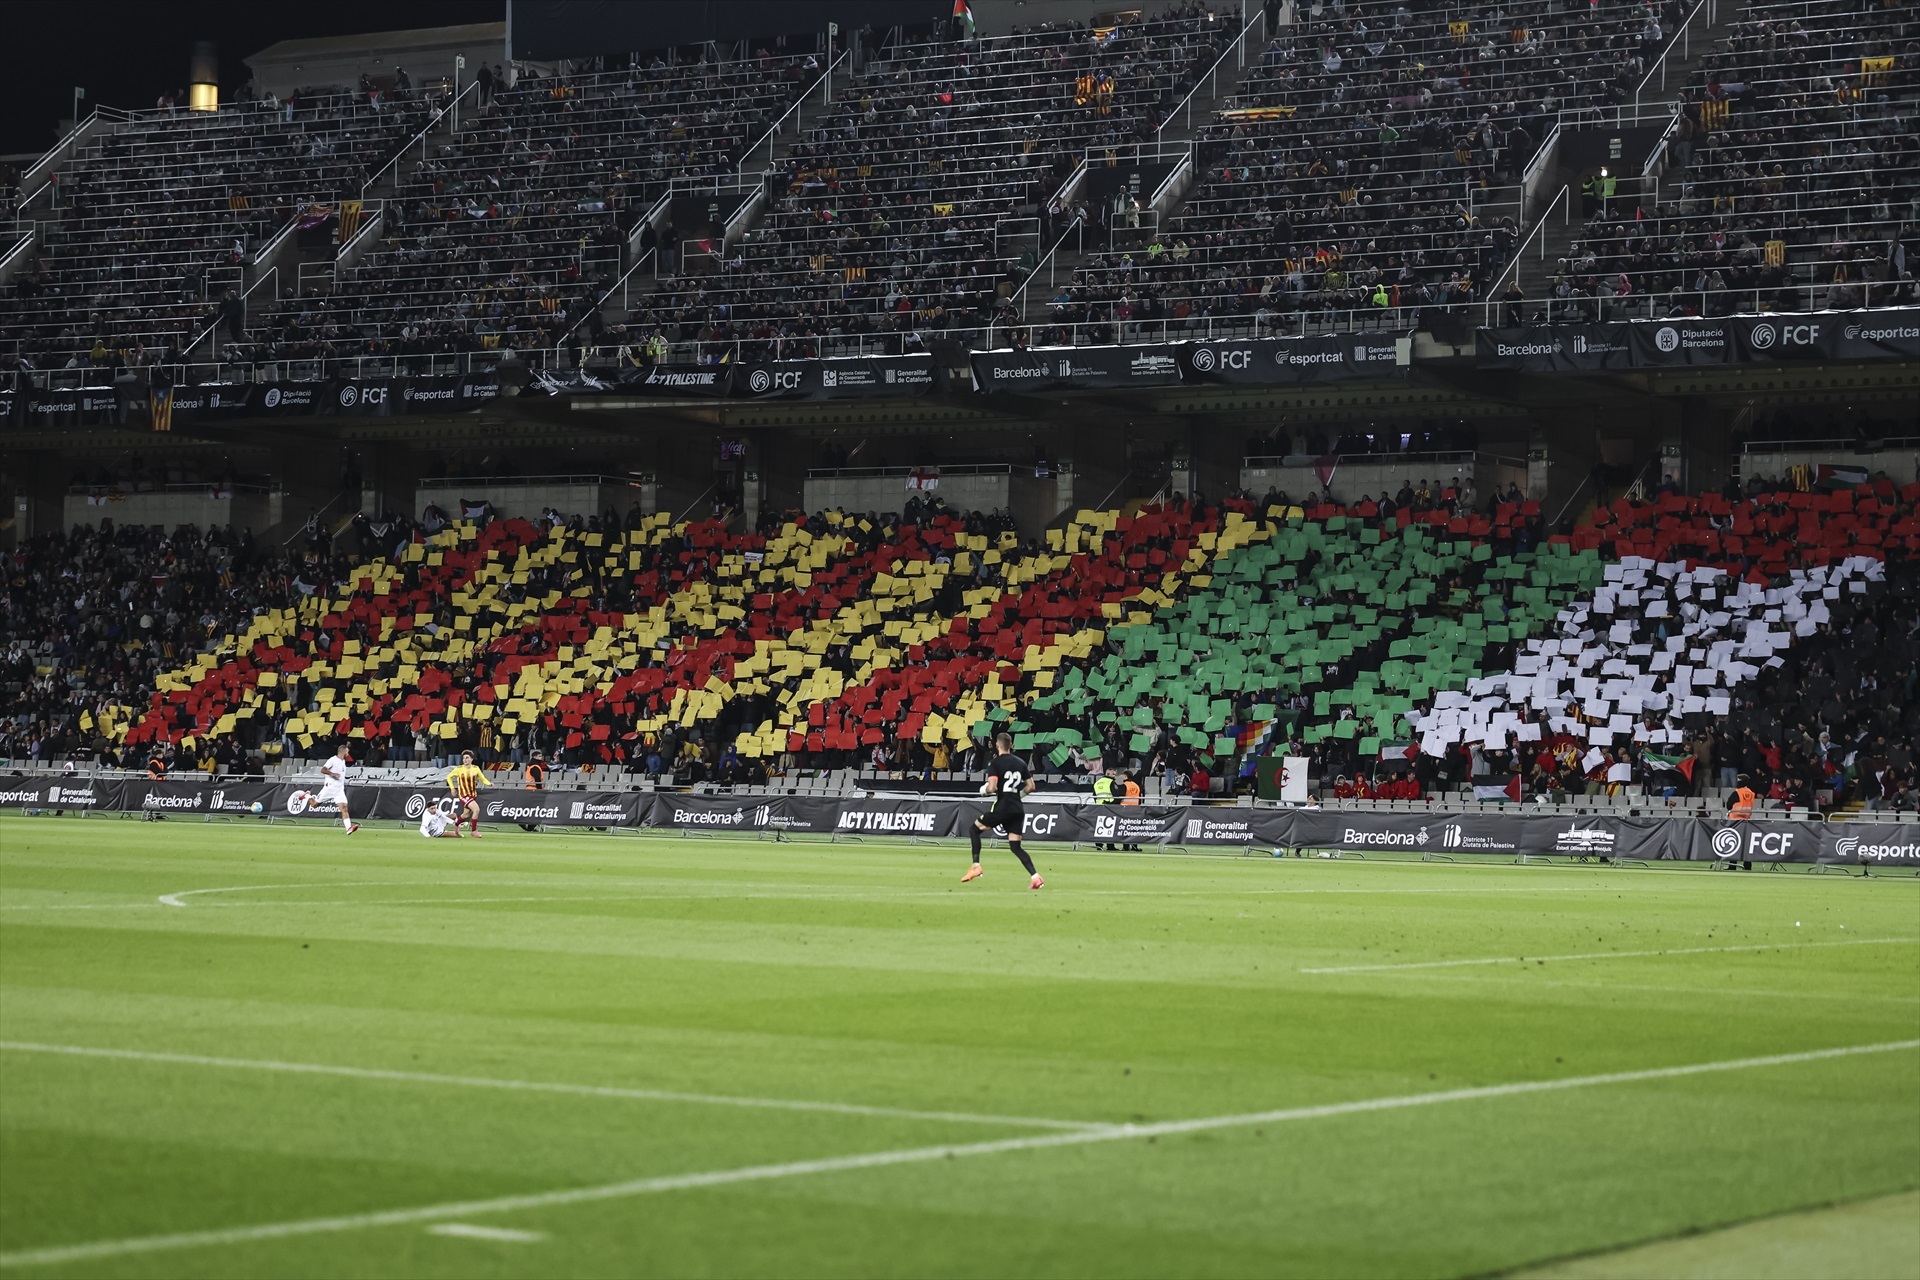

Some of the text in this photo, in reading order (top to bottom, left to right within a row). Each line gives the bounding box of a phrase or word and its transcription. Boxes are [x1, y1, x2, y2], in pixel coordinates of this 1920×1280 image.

[1682, 329, 1724, 338] Diputació
[1783, 325, 1820, 345] FCF
[1861, 326, 1920, 341] esportca
[1498, 343, 1552, 356] Barcelona
[1682, 340, 1724, 348] Barcelona
[1221, 350, 1252, 369] FCF
[1289, 352, 1343, 366] esportcat
[672, 373, 716, 385] PALESTINE
[994, 367, 1040, 378] Barcelona
[775, 372, 802, 388] FCF
[362, 388, 388, 404] FCF
[414, 388, 454, 404] esportcat
[38, 402, 76, 414] esportcat
[172, 399, 197, 408] celona
[1003, 771, 1022, 793] 22
[68, 796, 97, 805] Catalunya
[144, 794, 192, 808] Barcelona
[501, 805, 559, 820] esportcat
[594, 812, 626, 821] Catalunya
[674, 809, 732, 824] Barcelona
[838, 811, 936, 831] ACT X PALESTINE
[1022, 814, 1058, 834] FCF
[1205, 822, 1248, 830] Generalitat
[1204, 831, 1254, 841] de Catalunya
[1344, 828, 1414, 845] Barcelona
[1749, 832, 1794, 855] FCF
